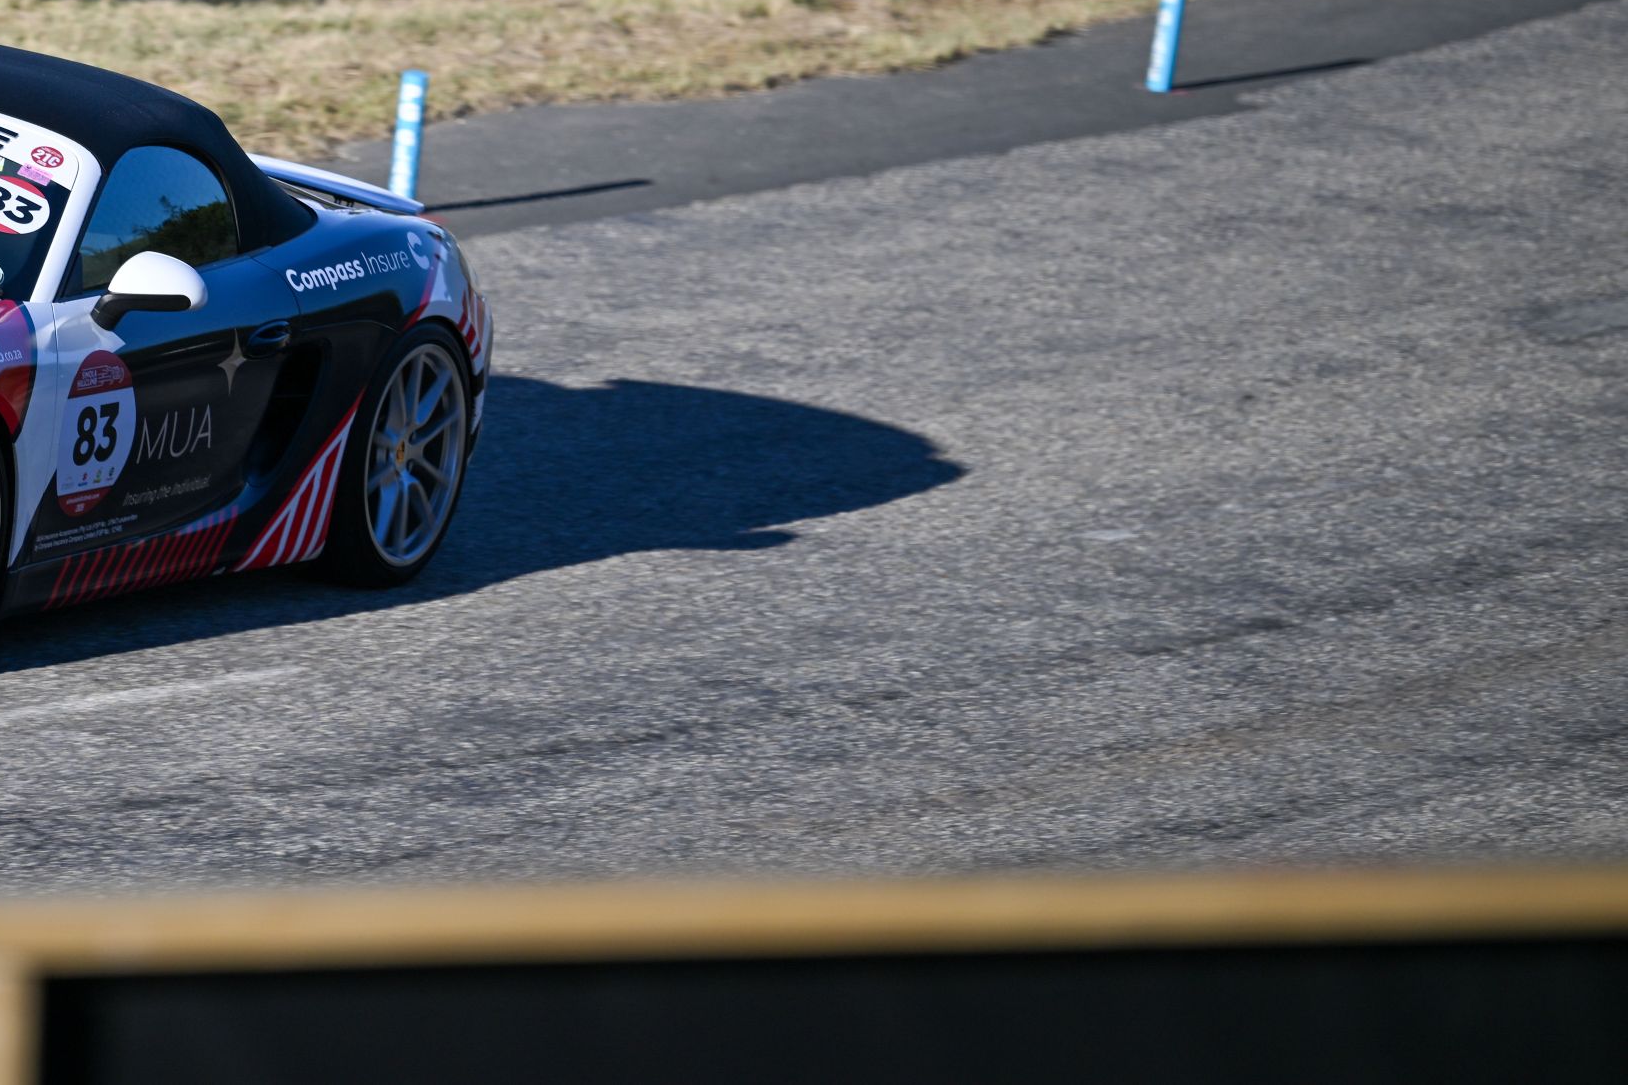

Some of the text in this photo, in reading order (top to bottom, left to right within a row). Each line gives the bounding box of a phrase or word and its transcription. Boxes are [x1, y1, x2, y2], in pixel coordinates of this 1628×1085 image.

[286, 250, 411, 291] Compass Insure
[72, 401, 120, 466] 83
[136, 403, 212, 464] MUA
